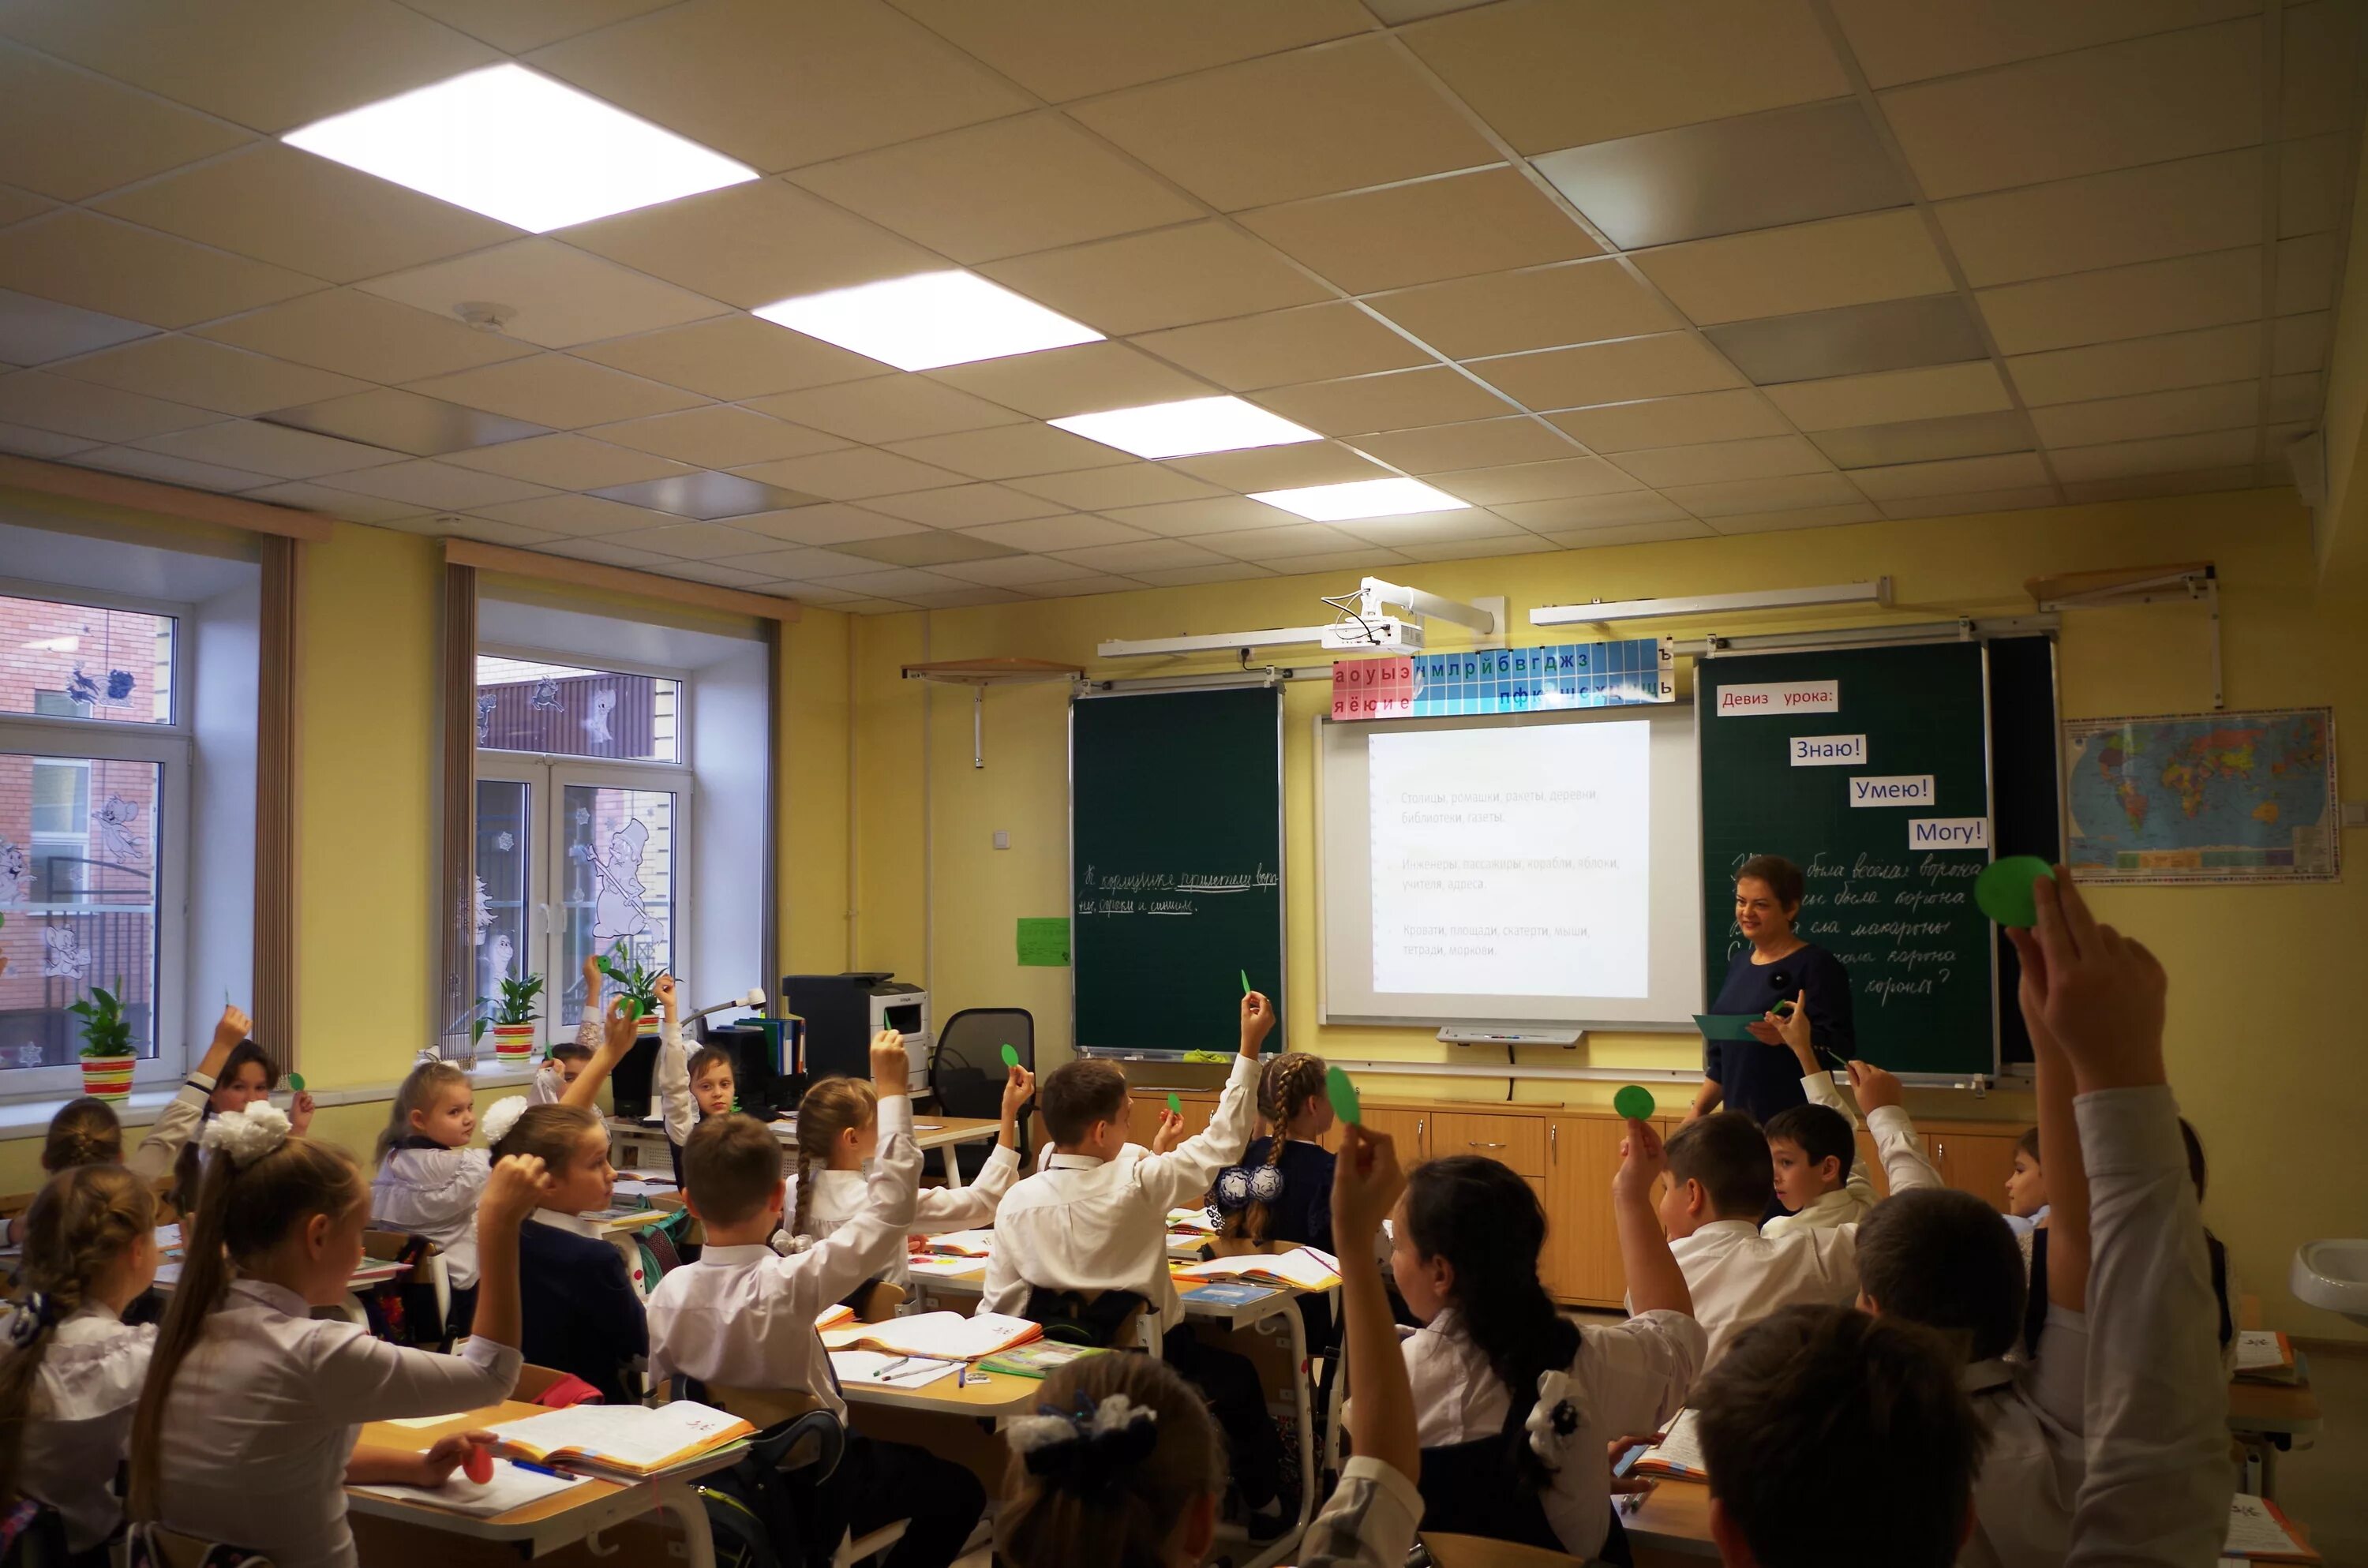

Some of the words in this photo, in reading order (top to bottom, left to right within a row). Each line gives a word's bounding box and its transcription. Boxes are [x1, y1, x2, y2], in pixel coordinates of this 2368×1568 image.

[1382, 668, 1395, 680] ы
[1400, 667, 1410, 679] э
[1482, 657, 1493, 675] й
[1498, 656, 1509, 671] б
[1532, 657, 1540, 670] г
[1544, 657, 1557, 672] д
[1334, 702, 1344, 713] я
[1350, 696, 1359, 712] ё
[1364, 700, 1377, 711] ю
[1400, 698, 1410, 709] е
[1722, 692, 1769, 708] Девиз
[1784, 690, 1834, 707] урока:
[1797, 739, 1860, 758] Знаю!
[1401, 791, 1449, 806] Столицы,
[1452, 791, 1503, 806] ромашки,
[1506, 790, 1547, 804] ракеты,
[1549, 788, 1598, 803] деревни,
[1857, 780, 1928, 799] Умею!
[1401, 811, 1464, 825] библиотеки,
[1916, 821, 1982, 844] Могу!
[1403, 858, 1459, 872] Инженеры,
[1463, 859, 1525, 872] пассажиры,
[1527, 856, 1576, 870] корабли,
[1578, 856, 1621, 870] яблоки,
[1807, 852, 1845, 878] была
[1403, 878, 1445, 893] учителя,
[1834, 880, 1881, 905] была
[1403, 925, 1448, 938] Кровати,
[1450, 925, 1501, 938] площади,
[1502, 925, 1552, 939] скатерти,
[1554, 926, 1591, 939] мыши,
[1403, 944, 1445, 958] тетради,
